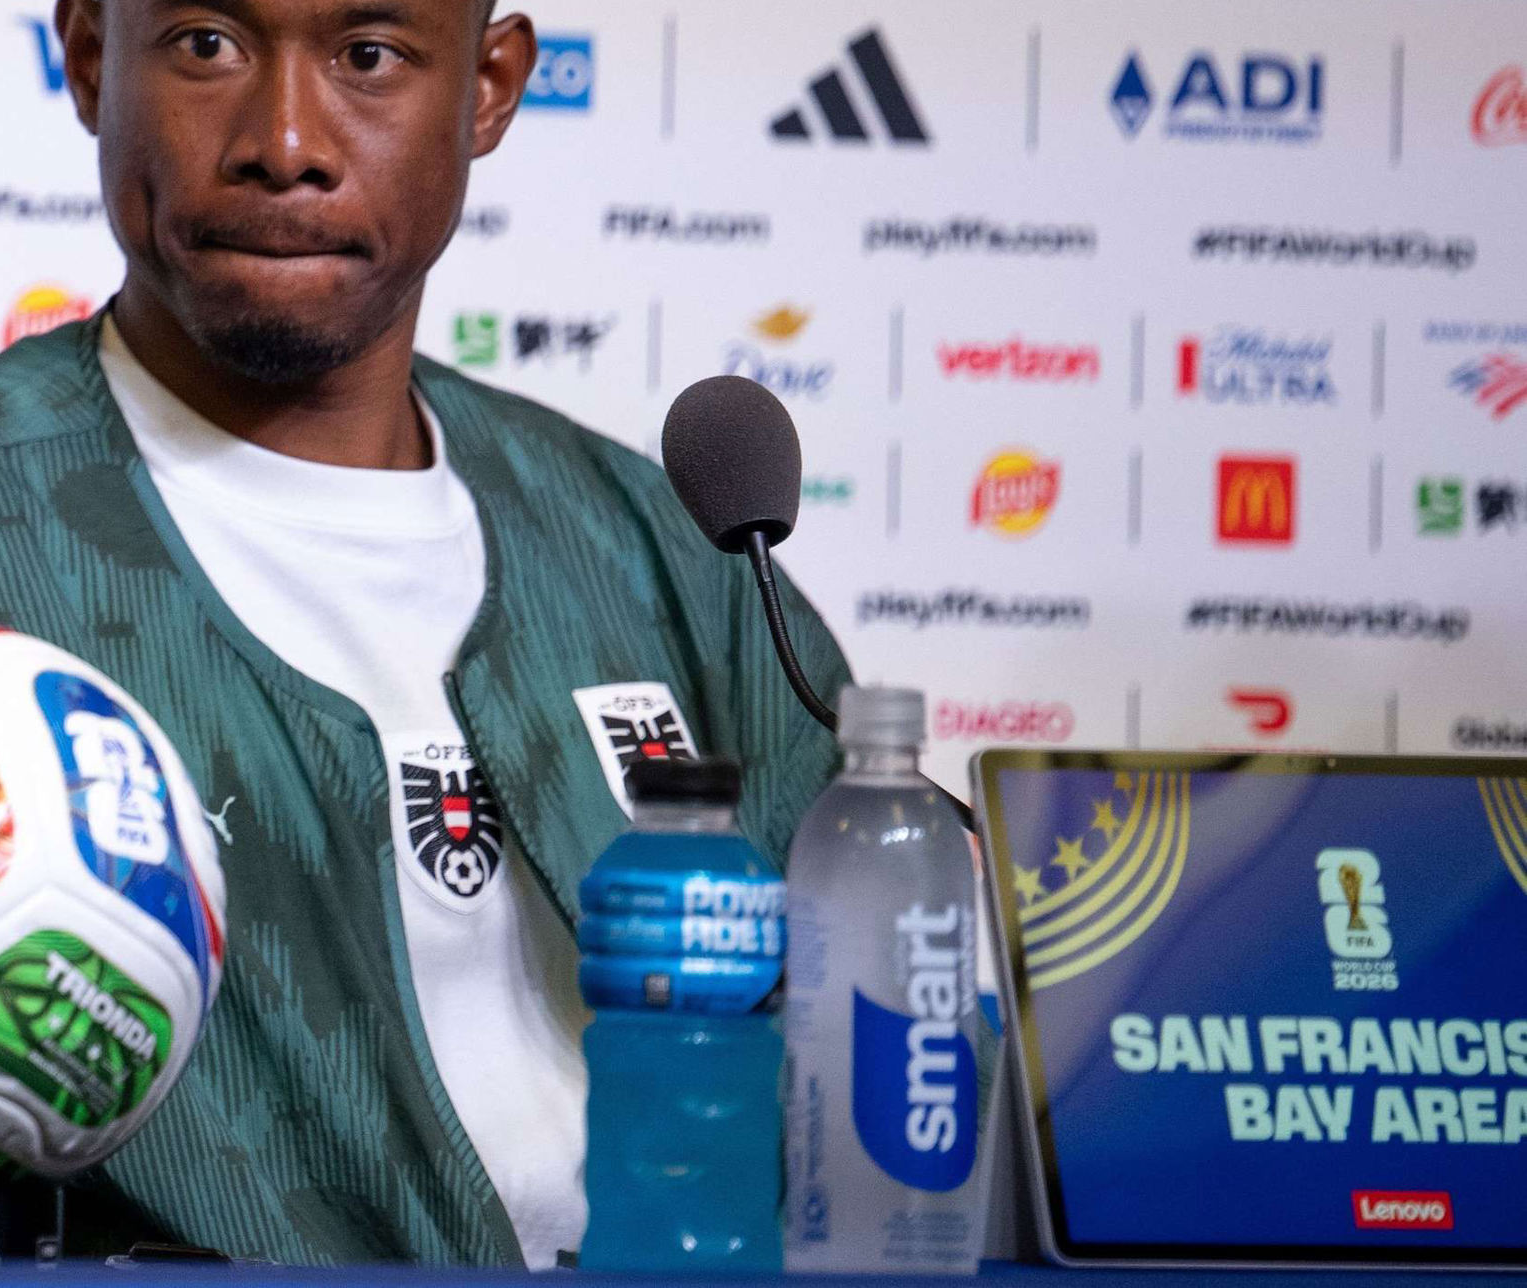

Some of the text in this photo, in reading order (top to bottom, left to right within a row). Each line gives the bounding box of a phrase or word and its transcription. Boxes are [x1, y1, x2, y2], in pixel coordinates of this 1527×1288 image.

[1170, 54, 1323, 118] ADI
[602, 206, 770, 243] FIFA.com
[938, 339, 1100, 382] verizon
[45, 948, 158, 1062] TRIONDA
[1333, 973, 1400, 991] 2026
[895, 902, 958, 1152] smart
[1111, 1015, 1251, 1074] SAN
[1225, 1086, 1353, 1143] BAY
[1359, 1196, 1445, 1223] Lenovo
